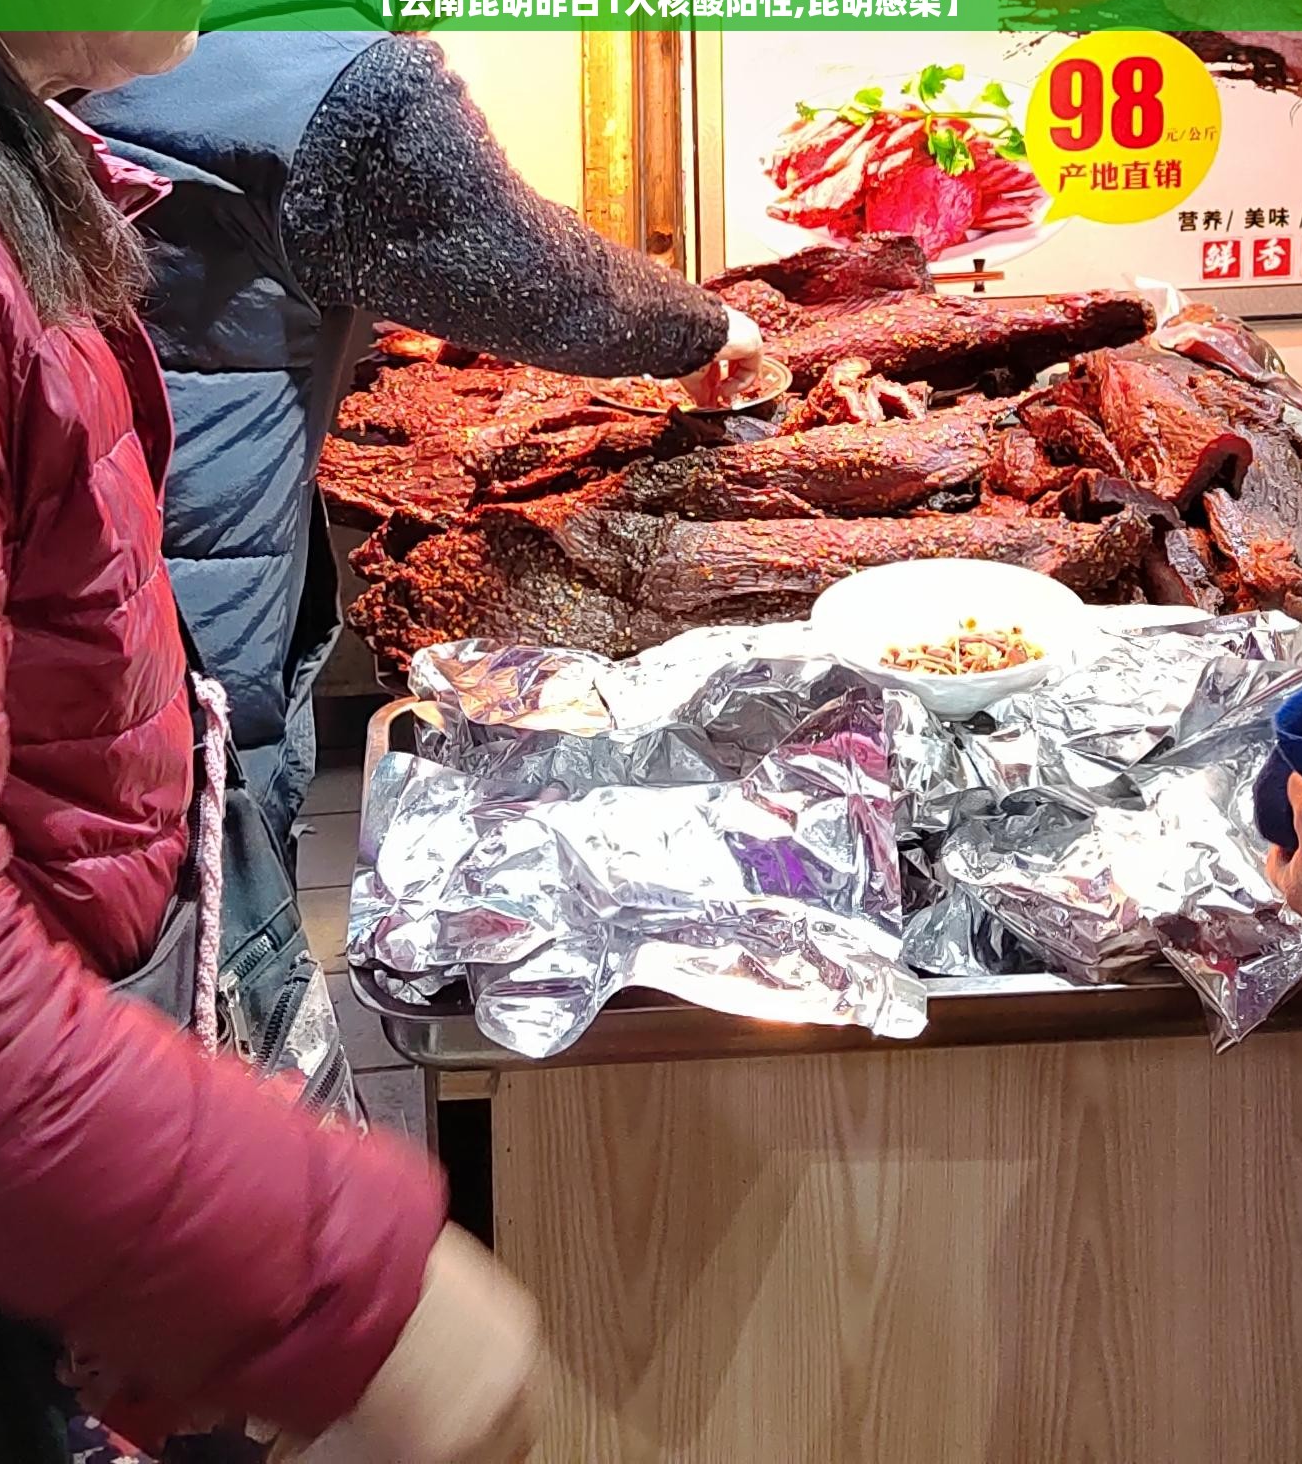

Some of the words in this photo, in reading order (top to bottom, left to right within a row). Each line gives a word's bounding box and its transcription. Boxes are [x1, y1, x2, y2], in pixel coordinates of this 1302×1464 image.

[1049, 56, 1164, 152] 98
[1059, 159, 1182, 192] 产地直销
